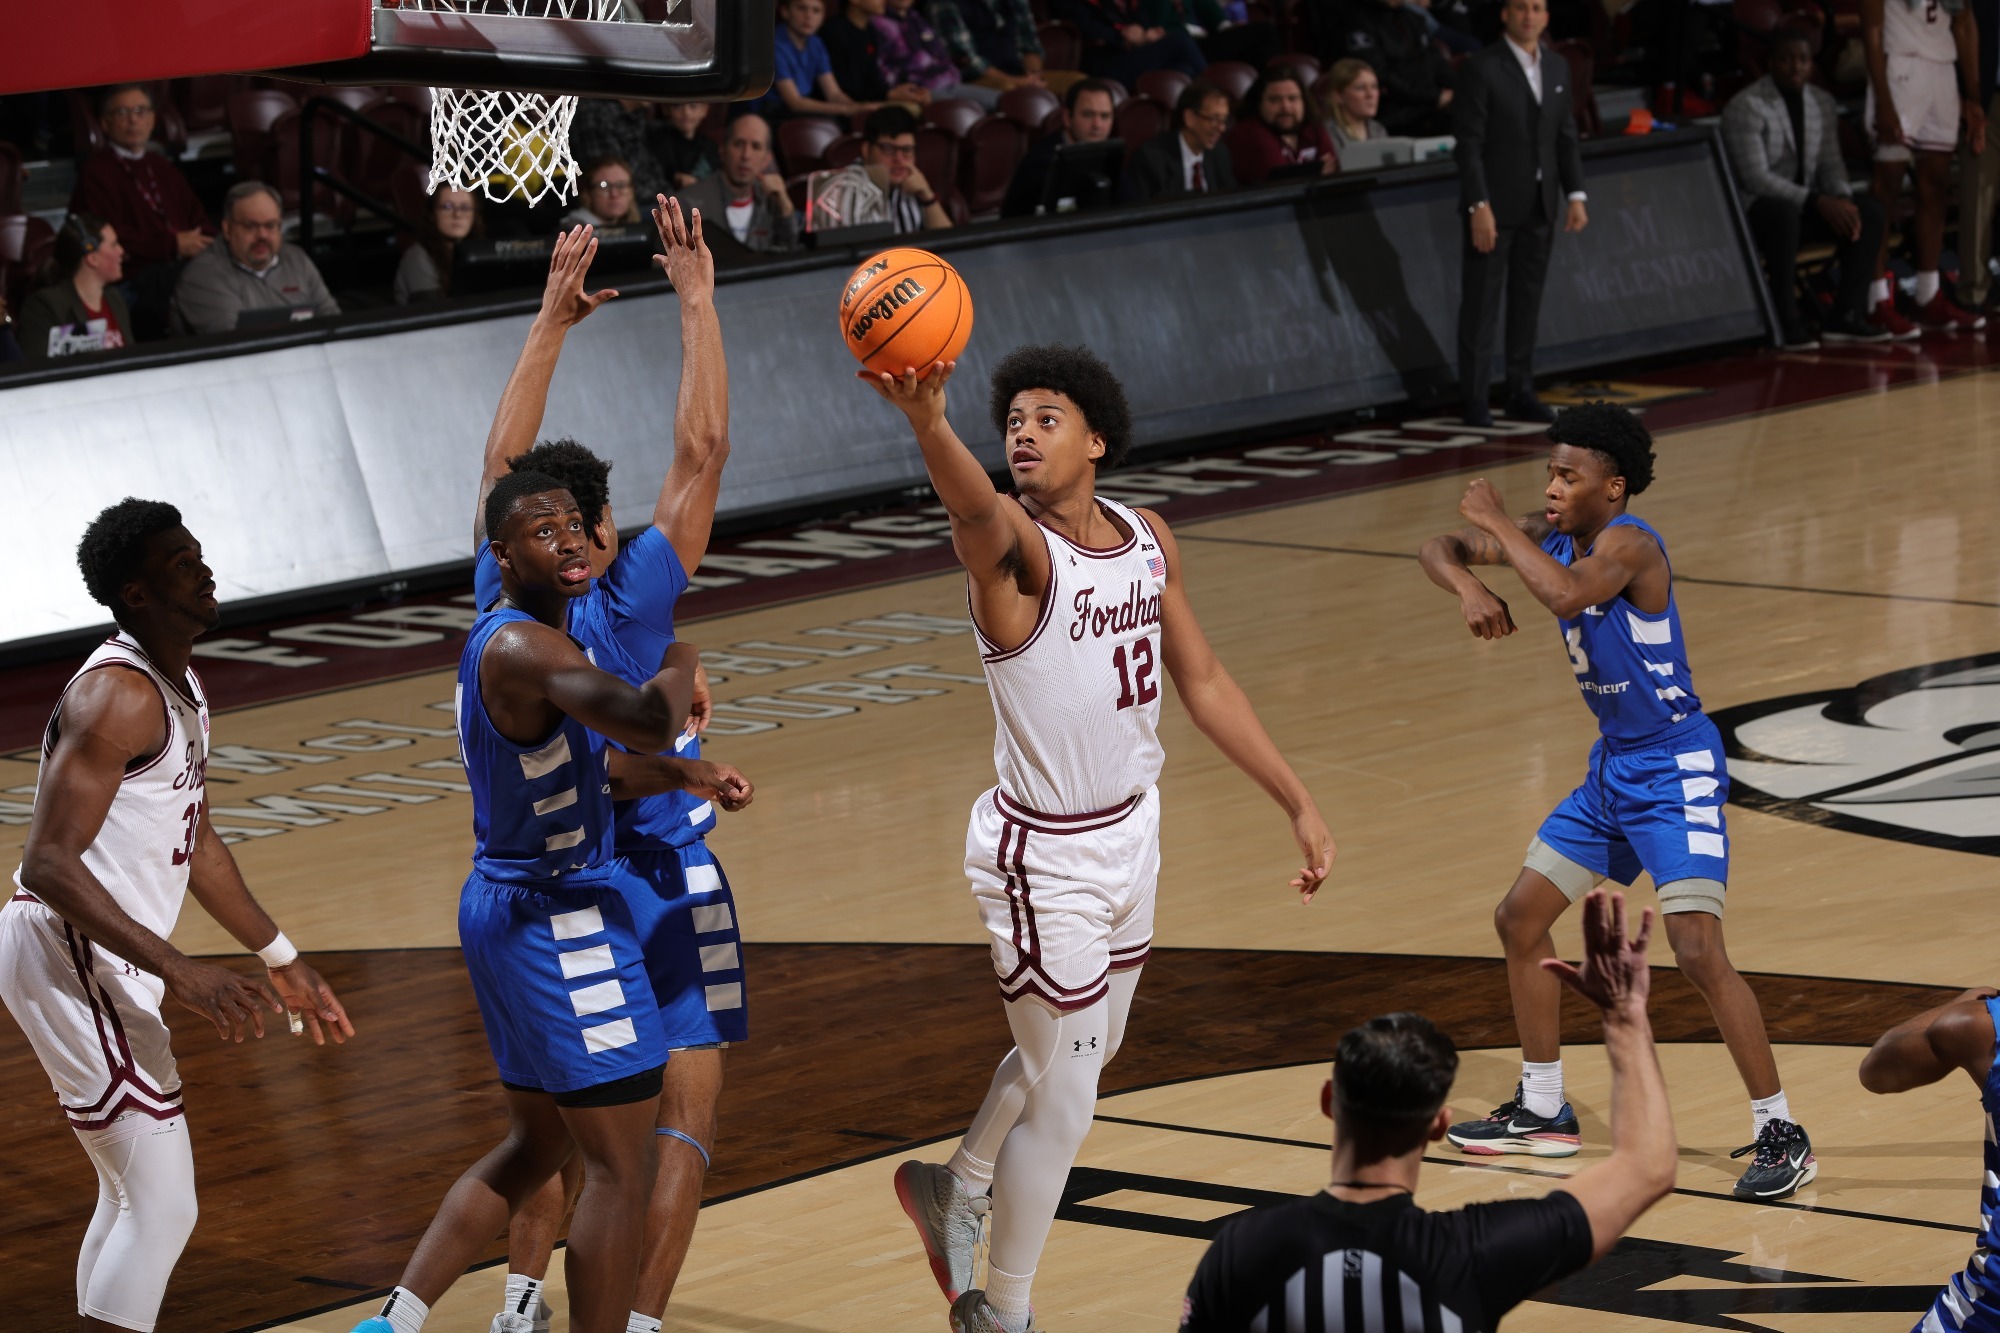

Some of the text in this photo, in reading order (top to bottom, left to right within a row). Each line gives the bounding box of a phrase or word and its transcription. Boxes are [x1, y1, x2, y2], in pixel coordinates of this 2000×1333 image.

[851, 277, 927, 342] Wilson
[1069, 579, 1162, 642] Fordha
[1113, 636, 1158, 711] 12
